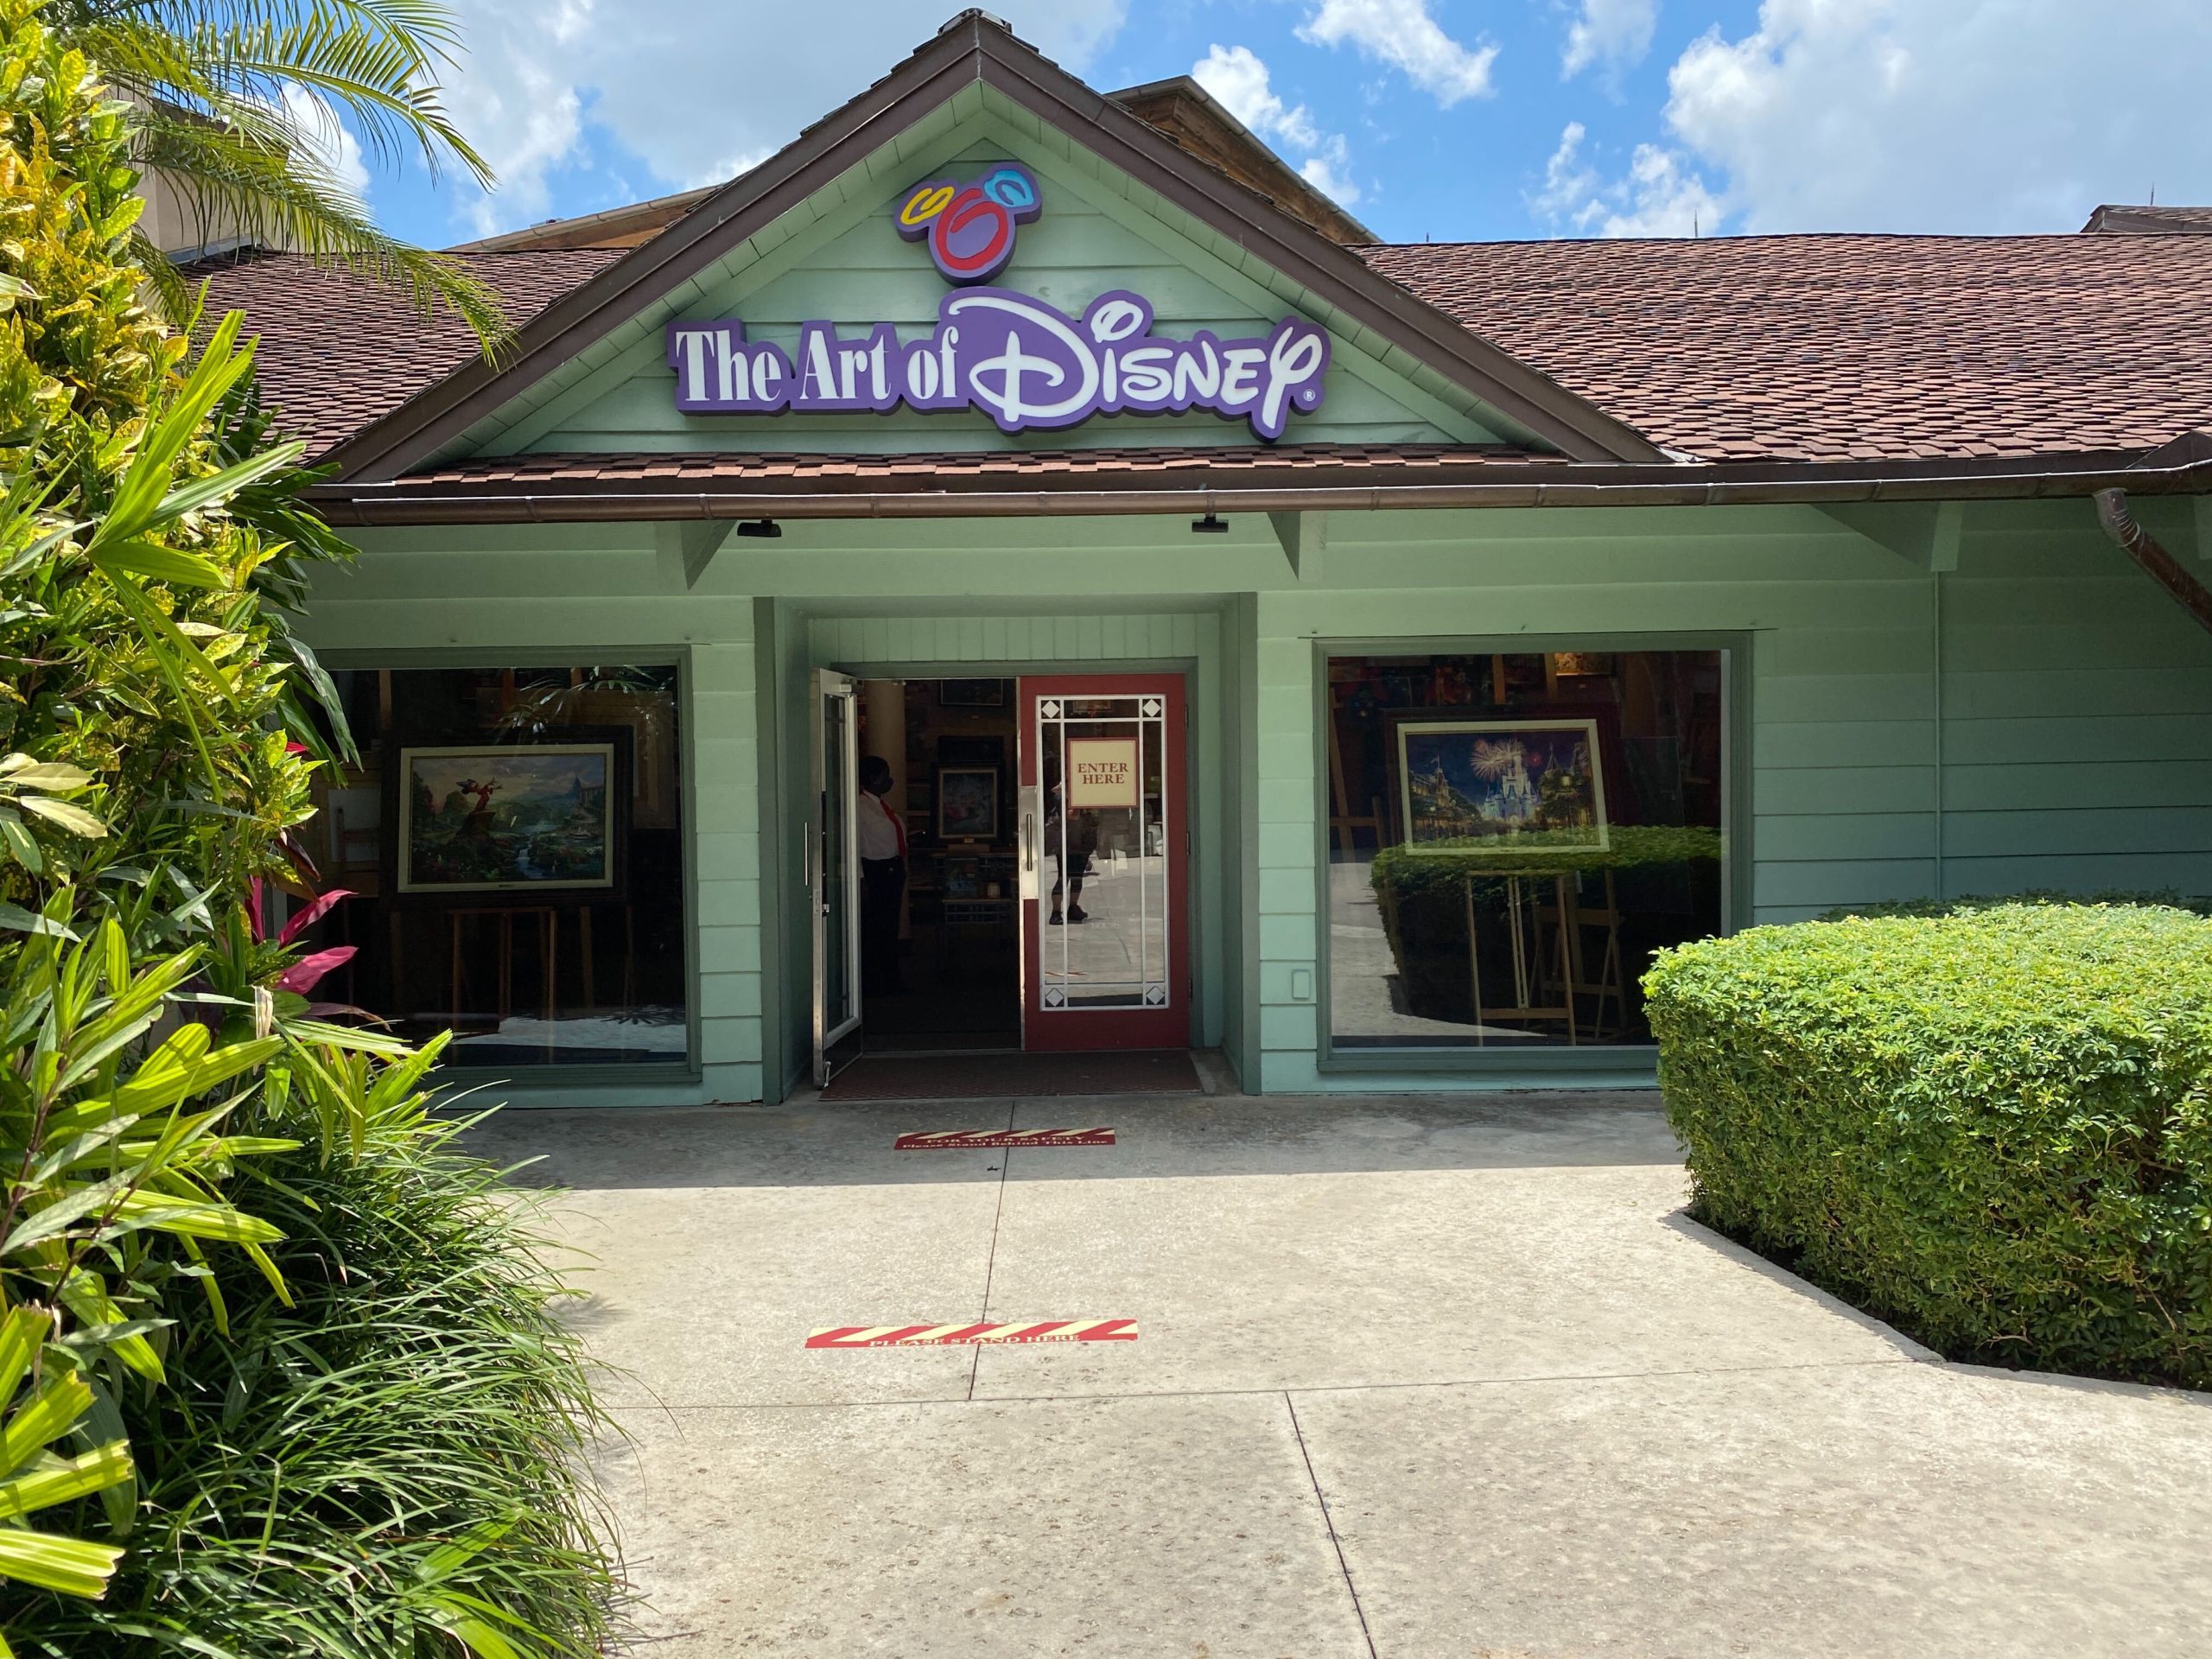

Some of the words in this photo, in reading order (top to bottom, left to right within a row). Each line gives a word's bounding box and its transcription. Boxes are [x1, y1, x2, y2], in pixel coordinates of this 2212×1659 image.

[676, 329, 783, 403] The
[798, 329, 893, 402] Art
[906, 325, 960, 399] of
[1077, 762, 1129, 773] ENTER
[1082, 773, 1126, 785] HERE
[868, 1338, 945, 1347] PLEASE
[950, 1336, 1020, 1344] STAND
[1027, 1334, 1081, 1343] HERE
